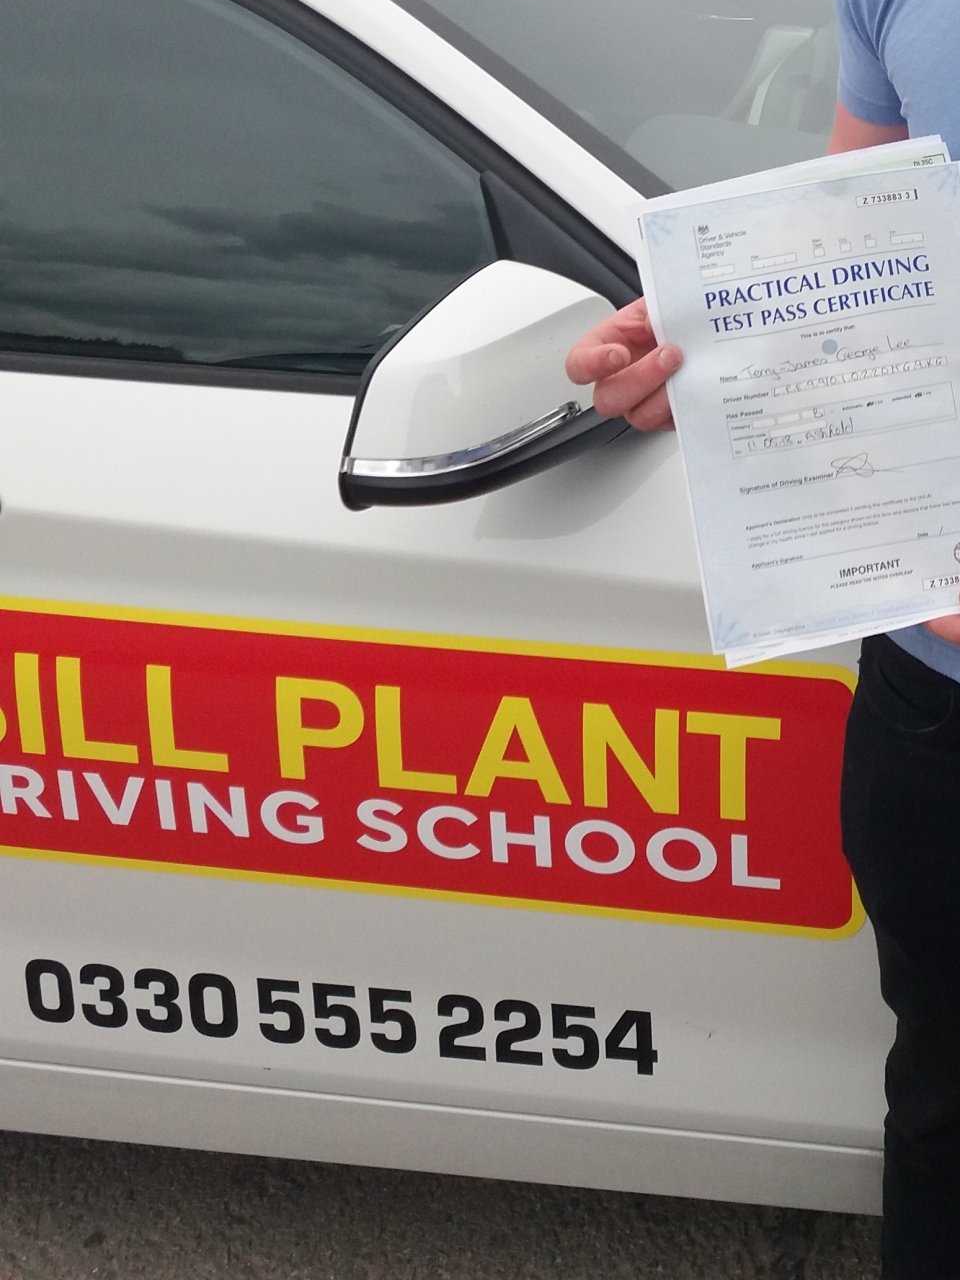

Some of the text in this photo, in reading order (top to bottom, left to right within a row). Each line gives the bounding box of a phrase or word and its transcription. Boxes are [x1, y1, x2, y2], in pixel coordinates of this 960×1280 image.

[705, 254, 931, 310] PRACTICAL DRIVING
[710, 280, 935, 333] TEST PASS CERTIFICATE
[839, 558, 901, 579] IMPORTANT
[0, 652, 782, 822] ILL PLANT
[356, 798, 782, 890] SCHOOL
[24, 958, 659, 1077] 0330 555 2254
